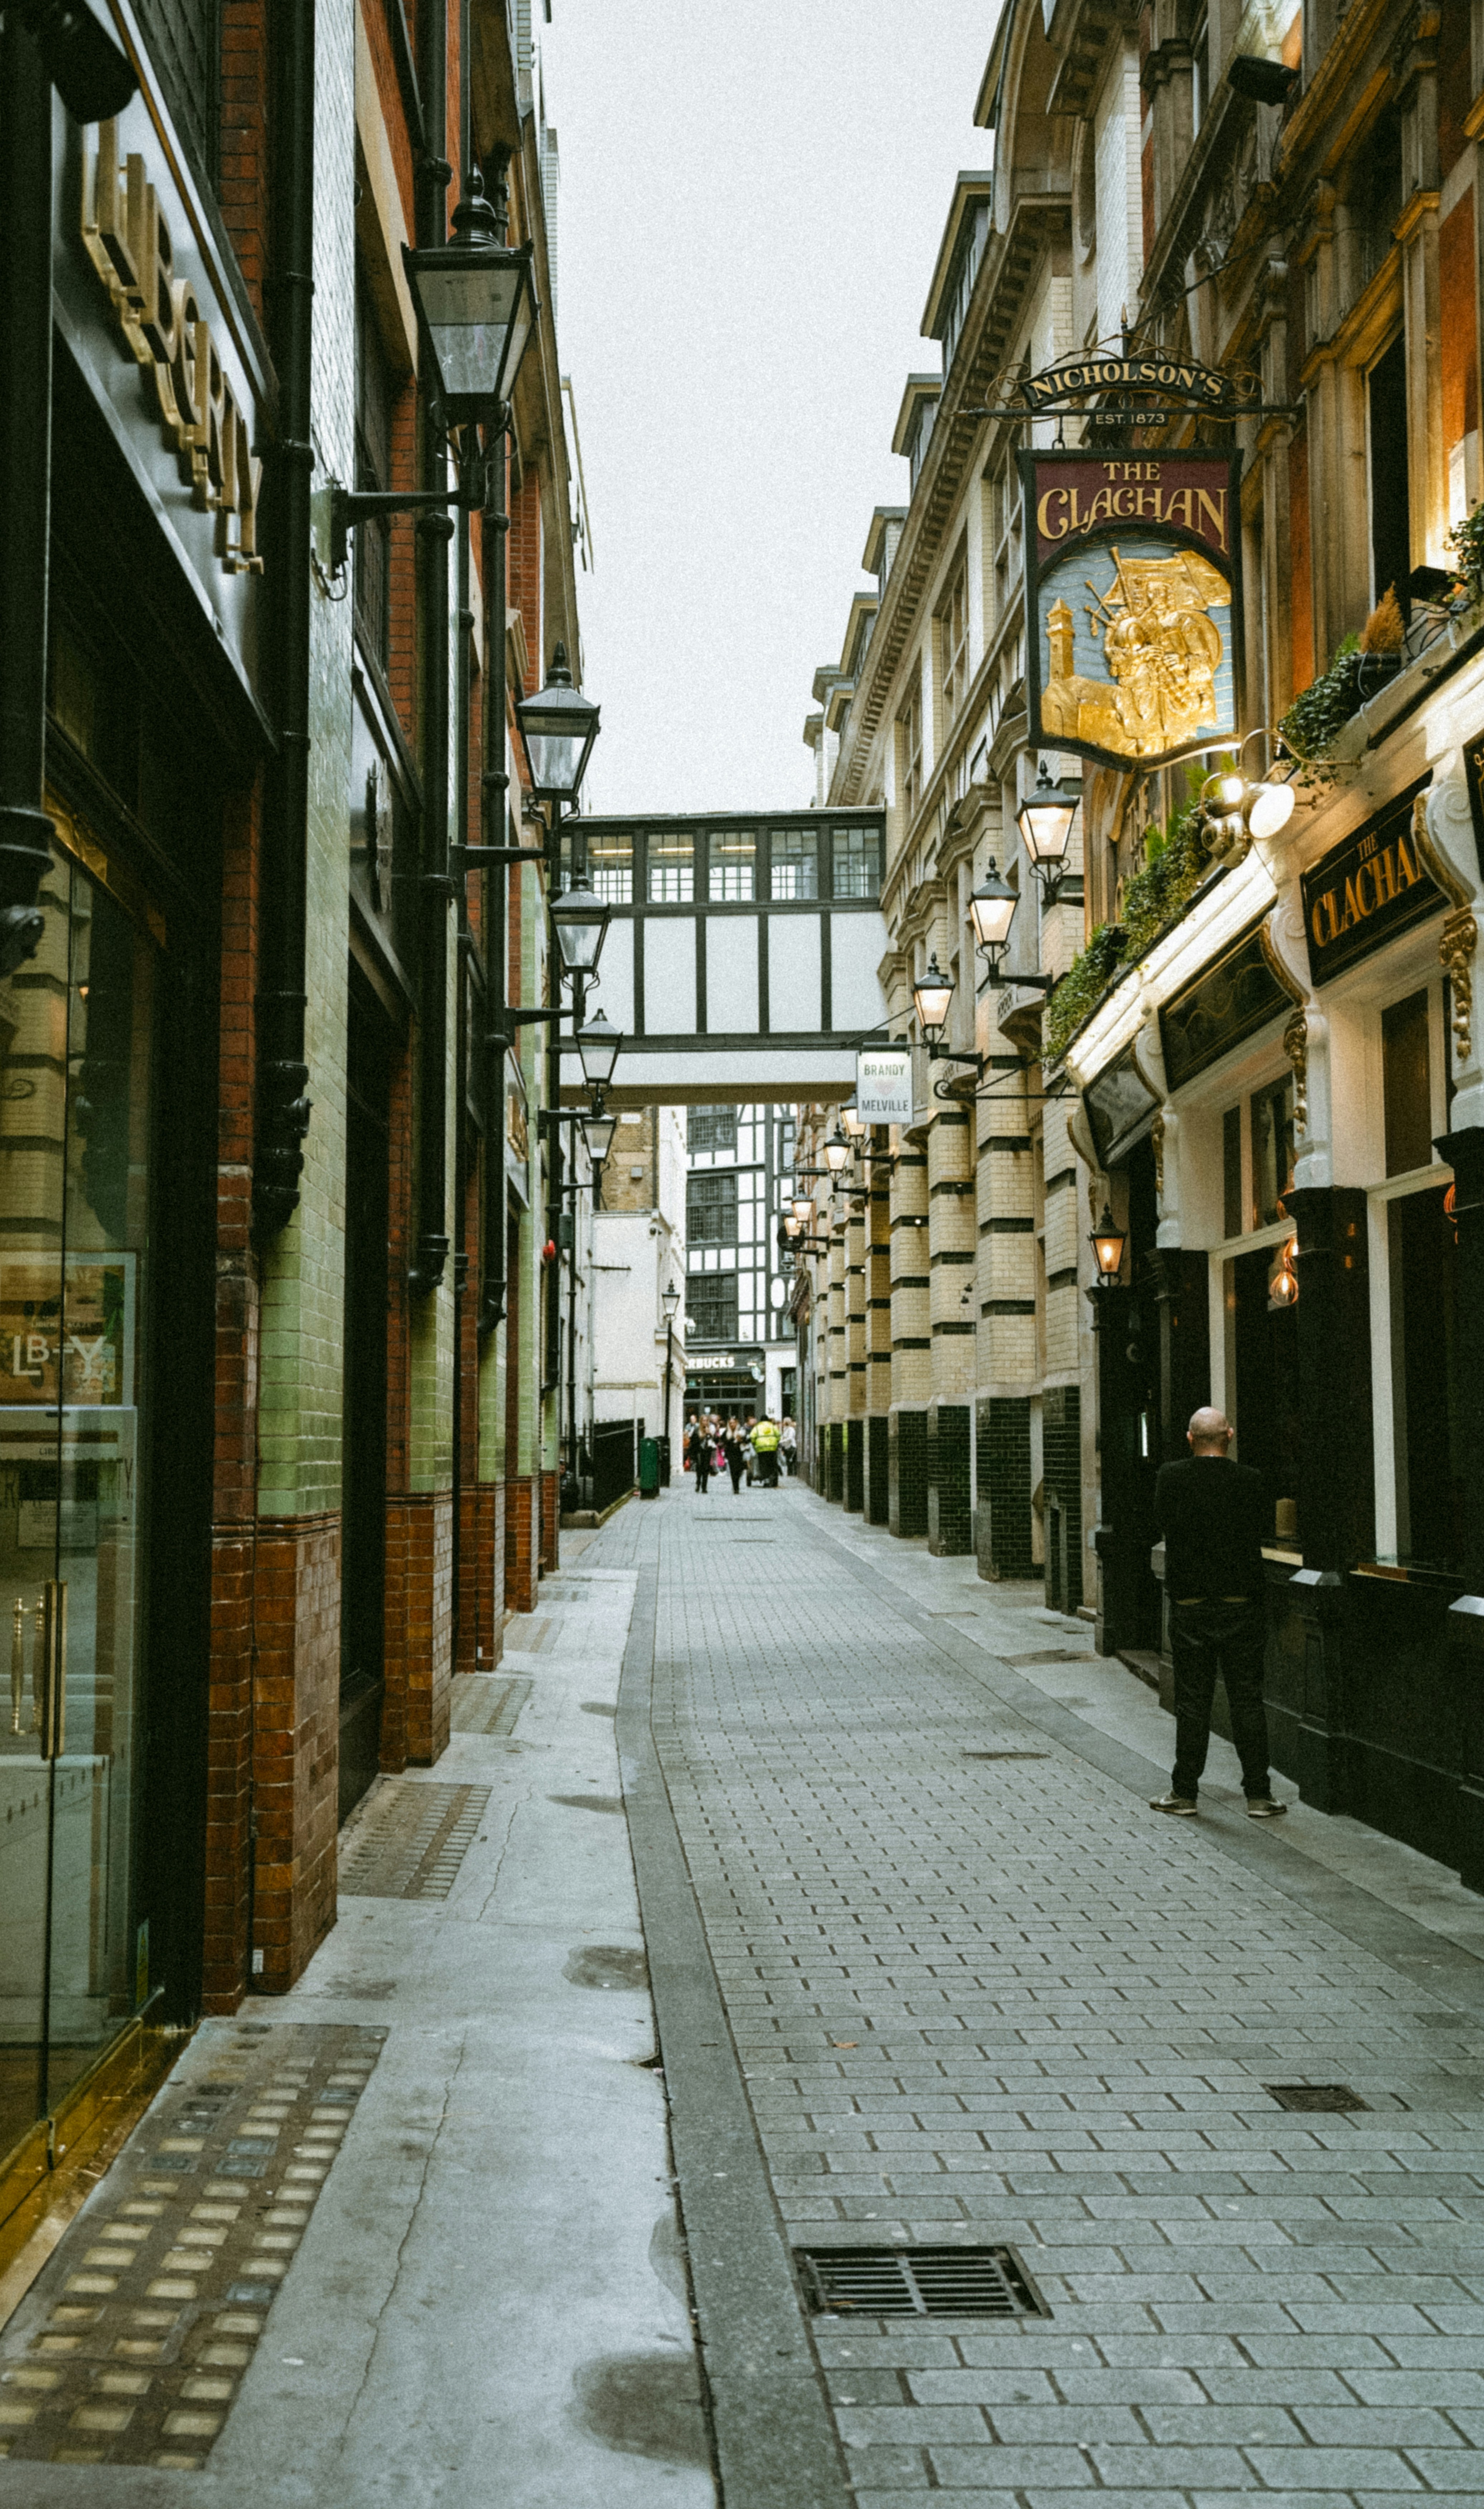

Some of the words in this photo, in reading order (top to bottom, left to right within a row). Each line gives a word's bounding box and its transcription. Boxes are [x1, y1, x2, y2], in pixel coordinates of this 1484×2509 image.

[1029, 362, 1223, 400] NICHOLSON'S
[1096, 414, 1126, 424] EST.
[1131, 413, 1165, 424] 1873
[1103, 463, 1160, 481] THE
[1036, 487, 1229, 555] CLACHAN
[1357, 830, 1378, 862] THE
[864, 1064, 905, 1076] BRANDY
[862, 1100, 909, 1111] MELVILLE
[685, 1357, 735, 1369] RBUCKS
